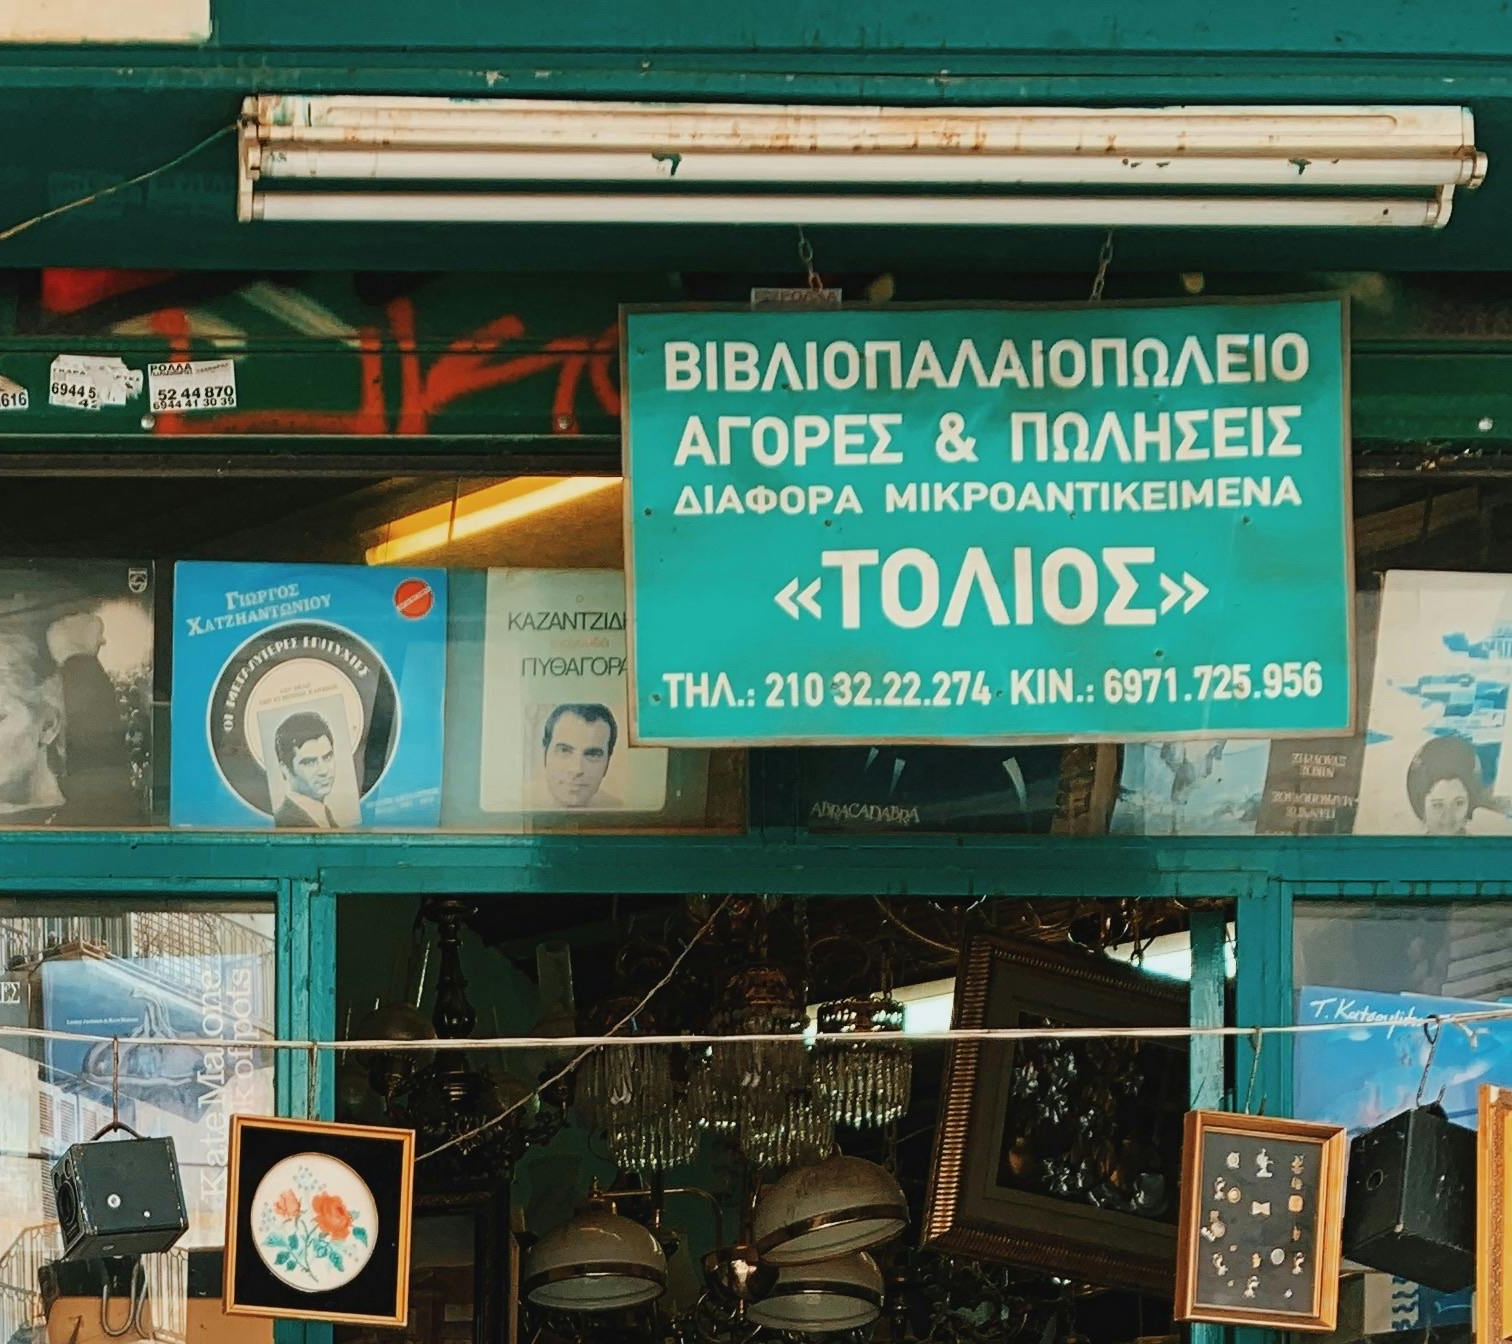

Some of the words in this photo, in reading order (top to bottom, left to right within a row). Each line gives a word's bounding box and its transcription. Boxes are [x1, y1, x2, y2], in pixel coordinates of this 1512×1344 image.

[663, 331, 1311, 393] ΒΙΒΛΙΟΠΑΛΑΙΟΠΩΛΕΙΟ
[152, 400, 182, 410] 6944
[185, 399, 199, 408] 41
[157, 389, 178, 401] 52
[180, 387, 201, 400] 44
[204, 385, 235, 399] 870
[672, 413, 904, 467] ΑΓΟΡΕΣ
[934, 411, 979, 464] &
[1011, 405, 1303, 464] ΠΩΛΗΣΕΙΣ
[673, 483, 864, 516] ΔΙΑΦΟΡΑ
[885, 475, 1303, 514] ΜΙΚΡΟΑΝΤΙΚΕΙΜΕΝΑ
[225, 583, 299, 611] ΓΙΩΡΓΟΣ
[774, 546, 1210, 630] «ΤΟΛΙΟΣ»
[186, 593, 332, 637] ΧΑΤΖΗΑΝΤΩΝΙΟΥ
[662, 672, 757, 709] ΤΗΛ.:
[764, 672, 833, 708] 210
[834, 669, 991, 708] 32.22.274
[1010, 667, 1096, 706] ΚΙΝ.:
[1103, 660, 1323, 706] 6971.725.956
[809, 801, 920, 826] ABRACADABRA
[226, 968, 261, 1041] pots
[197, 967, 227, 1110] Malone
[199, 1113, 229, 1204] Kate
